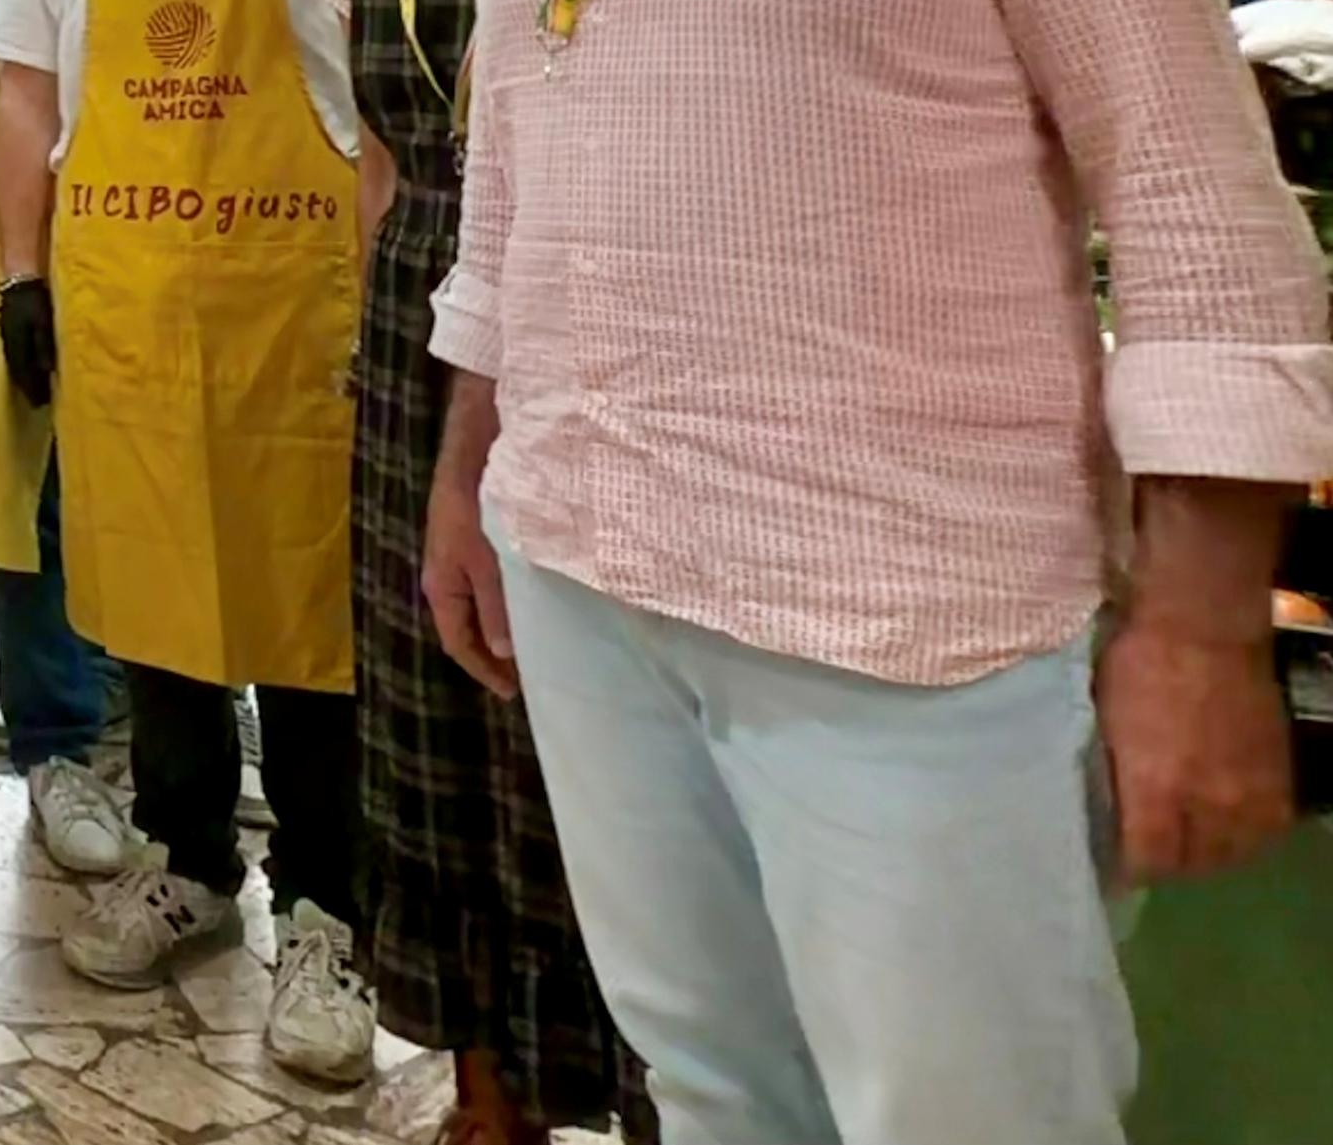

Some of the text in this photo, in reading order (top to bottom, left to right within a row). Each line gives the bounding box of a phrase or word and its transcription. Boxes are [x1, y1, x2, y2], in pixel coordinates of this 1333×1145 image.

[124, 75, 248, 100] CAMPAGNA
[143, 100, 226, 121] AMICA
[70, 183, 338, 235] Il CIBO giusto
